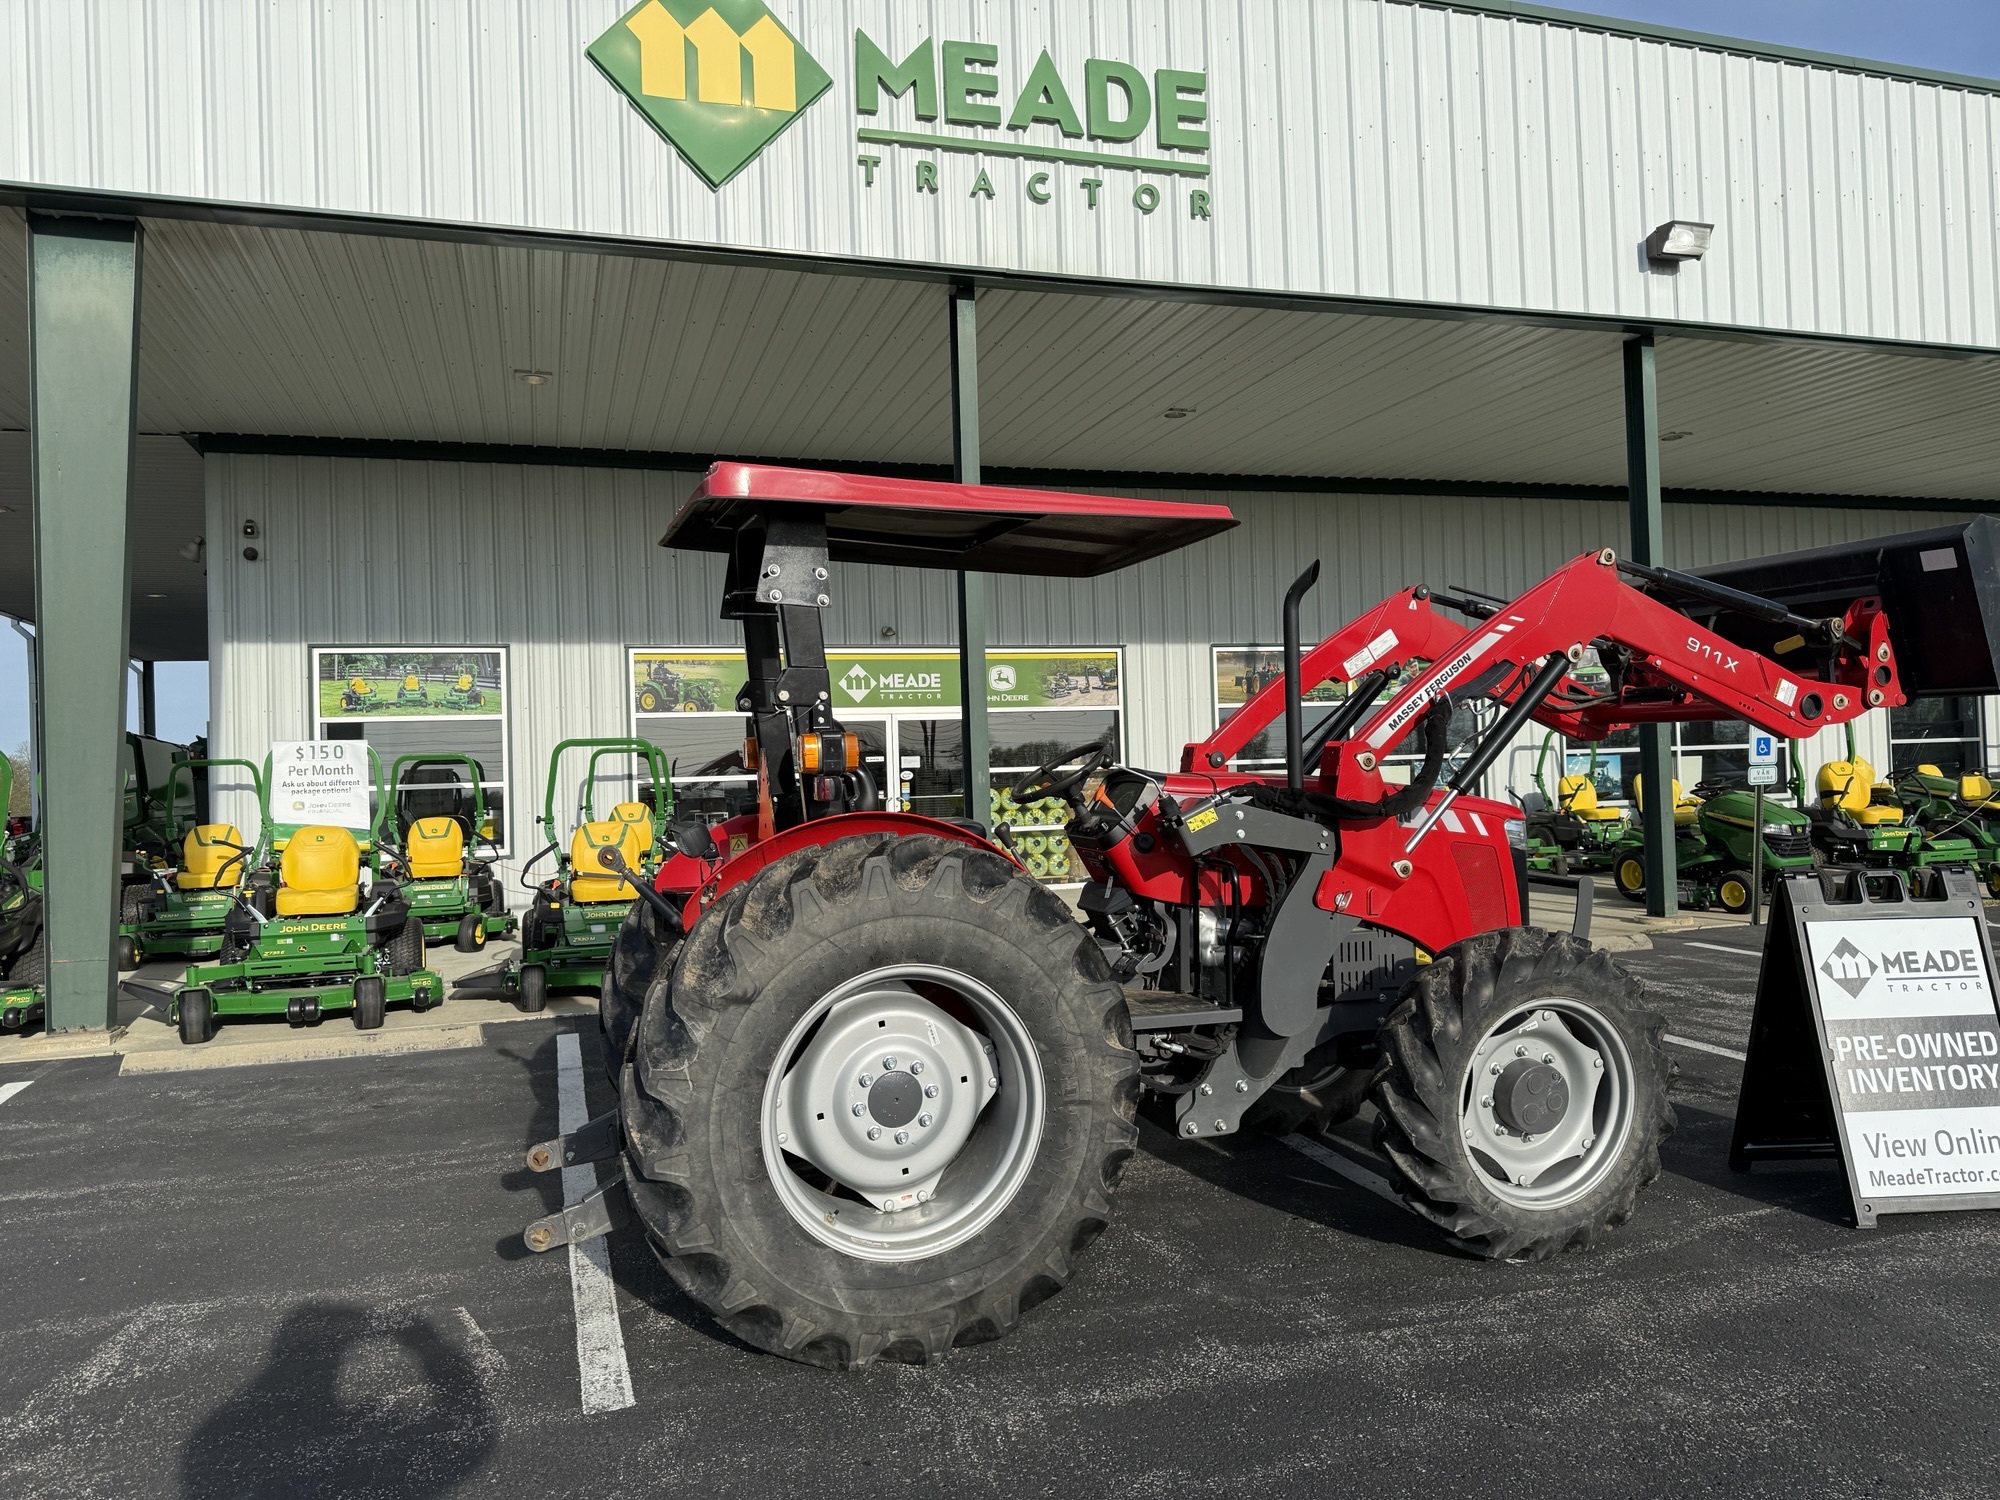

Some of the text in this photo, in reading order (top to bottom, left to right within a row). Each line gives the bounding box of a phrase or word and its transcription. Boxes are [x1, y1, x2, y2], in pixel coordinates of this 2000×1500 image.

[855, 27, 1210, 151] MEADE
[858, 153, 1211, 219] TRACTOR
[1686, 636, 1740, 674] 911X
[879, 673, 941, 688] MEADE
[1001, 694, 1029, 702] DEERE
[1387, 693, 1426, 731] MASSEY
[1423, 652, 1473, 699] FERGUSON
[295, 744, 344, 761] $150
[288, 764, 354, 776] Per Month
[282, 780, 295, 788] Ask
[291, 787, 351, 796] package options!
[586, 911, 606, 919] JOHN
[280, 922, 347, 933] JOHN DEERE
[1881, 949, 1978, 974] MEADE
[1887, 981, 1983, 993] TRACTOR
[1836, 1031, 1998, 1062] PRE-OWNED
[1847, 1063, 2000, 1094] INVENTORY
[1862, 1131, 1927, 1158] View
